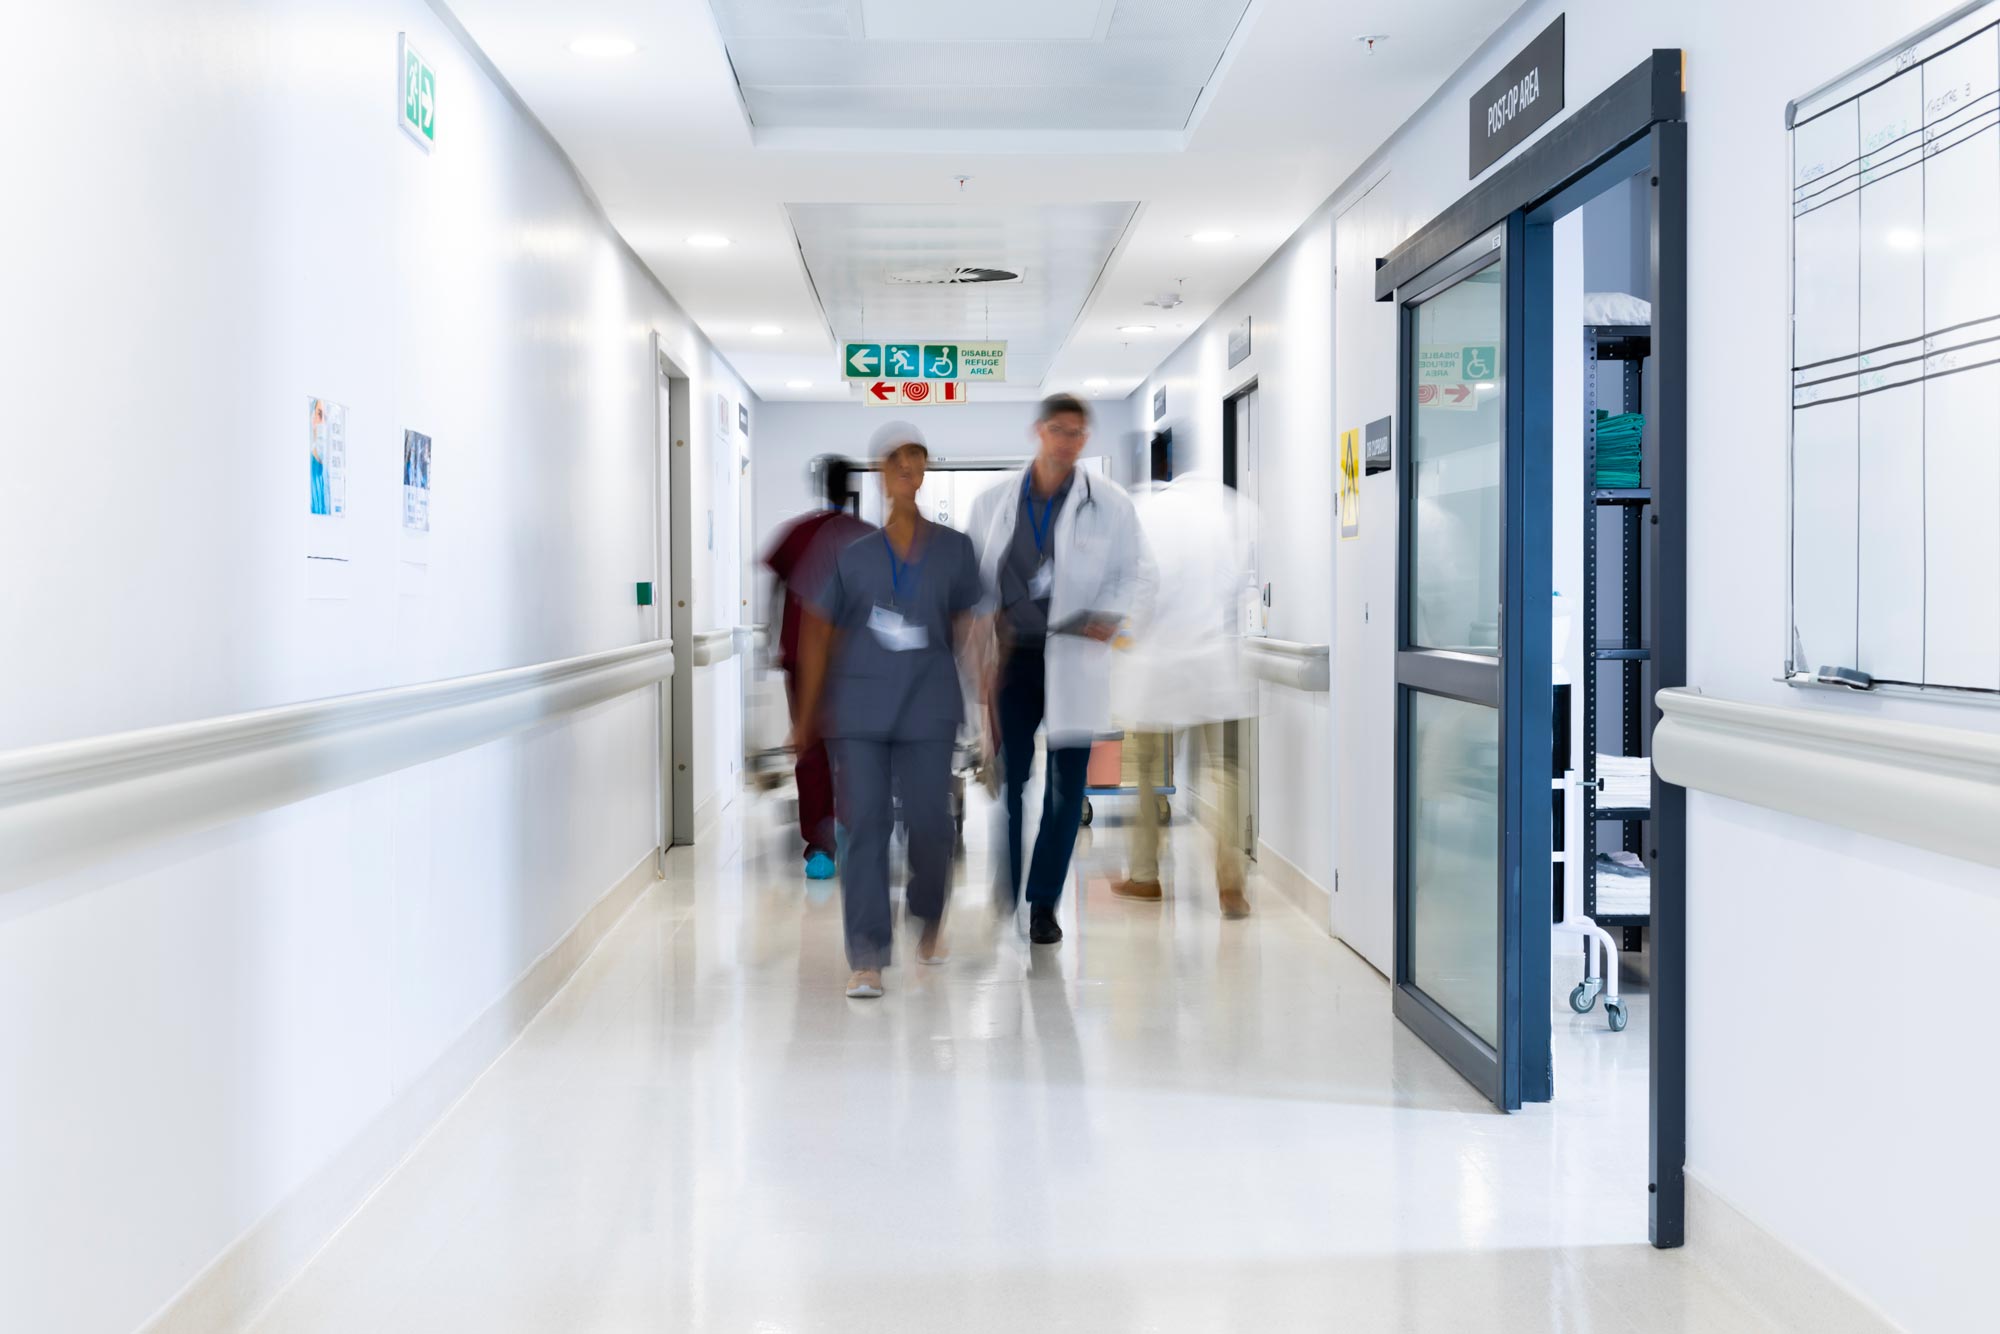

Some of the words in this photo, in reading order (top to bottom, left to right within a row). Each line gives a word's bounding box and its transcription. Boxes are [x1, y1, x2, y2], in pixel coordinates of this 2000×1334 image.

[1895, 46, 1917, 73] DATE
[1487, 84, 1519, 138] POST-OP
[1518, 66, 1540, 113] AREA
[1926, 89, 1958, 117] THEATRE
[964, 358, 999, 366] REFUGE
